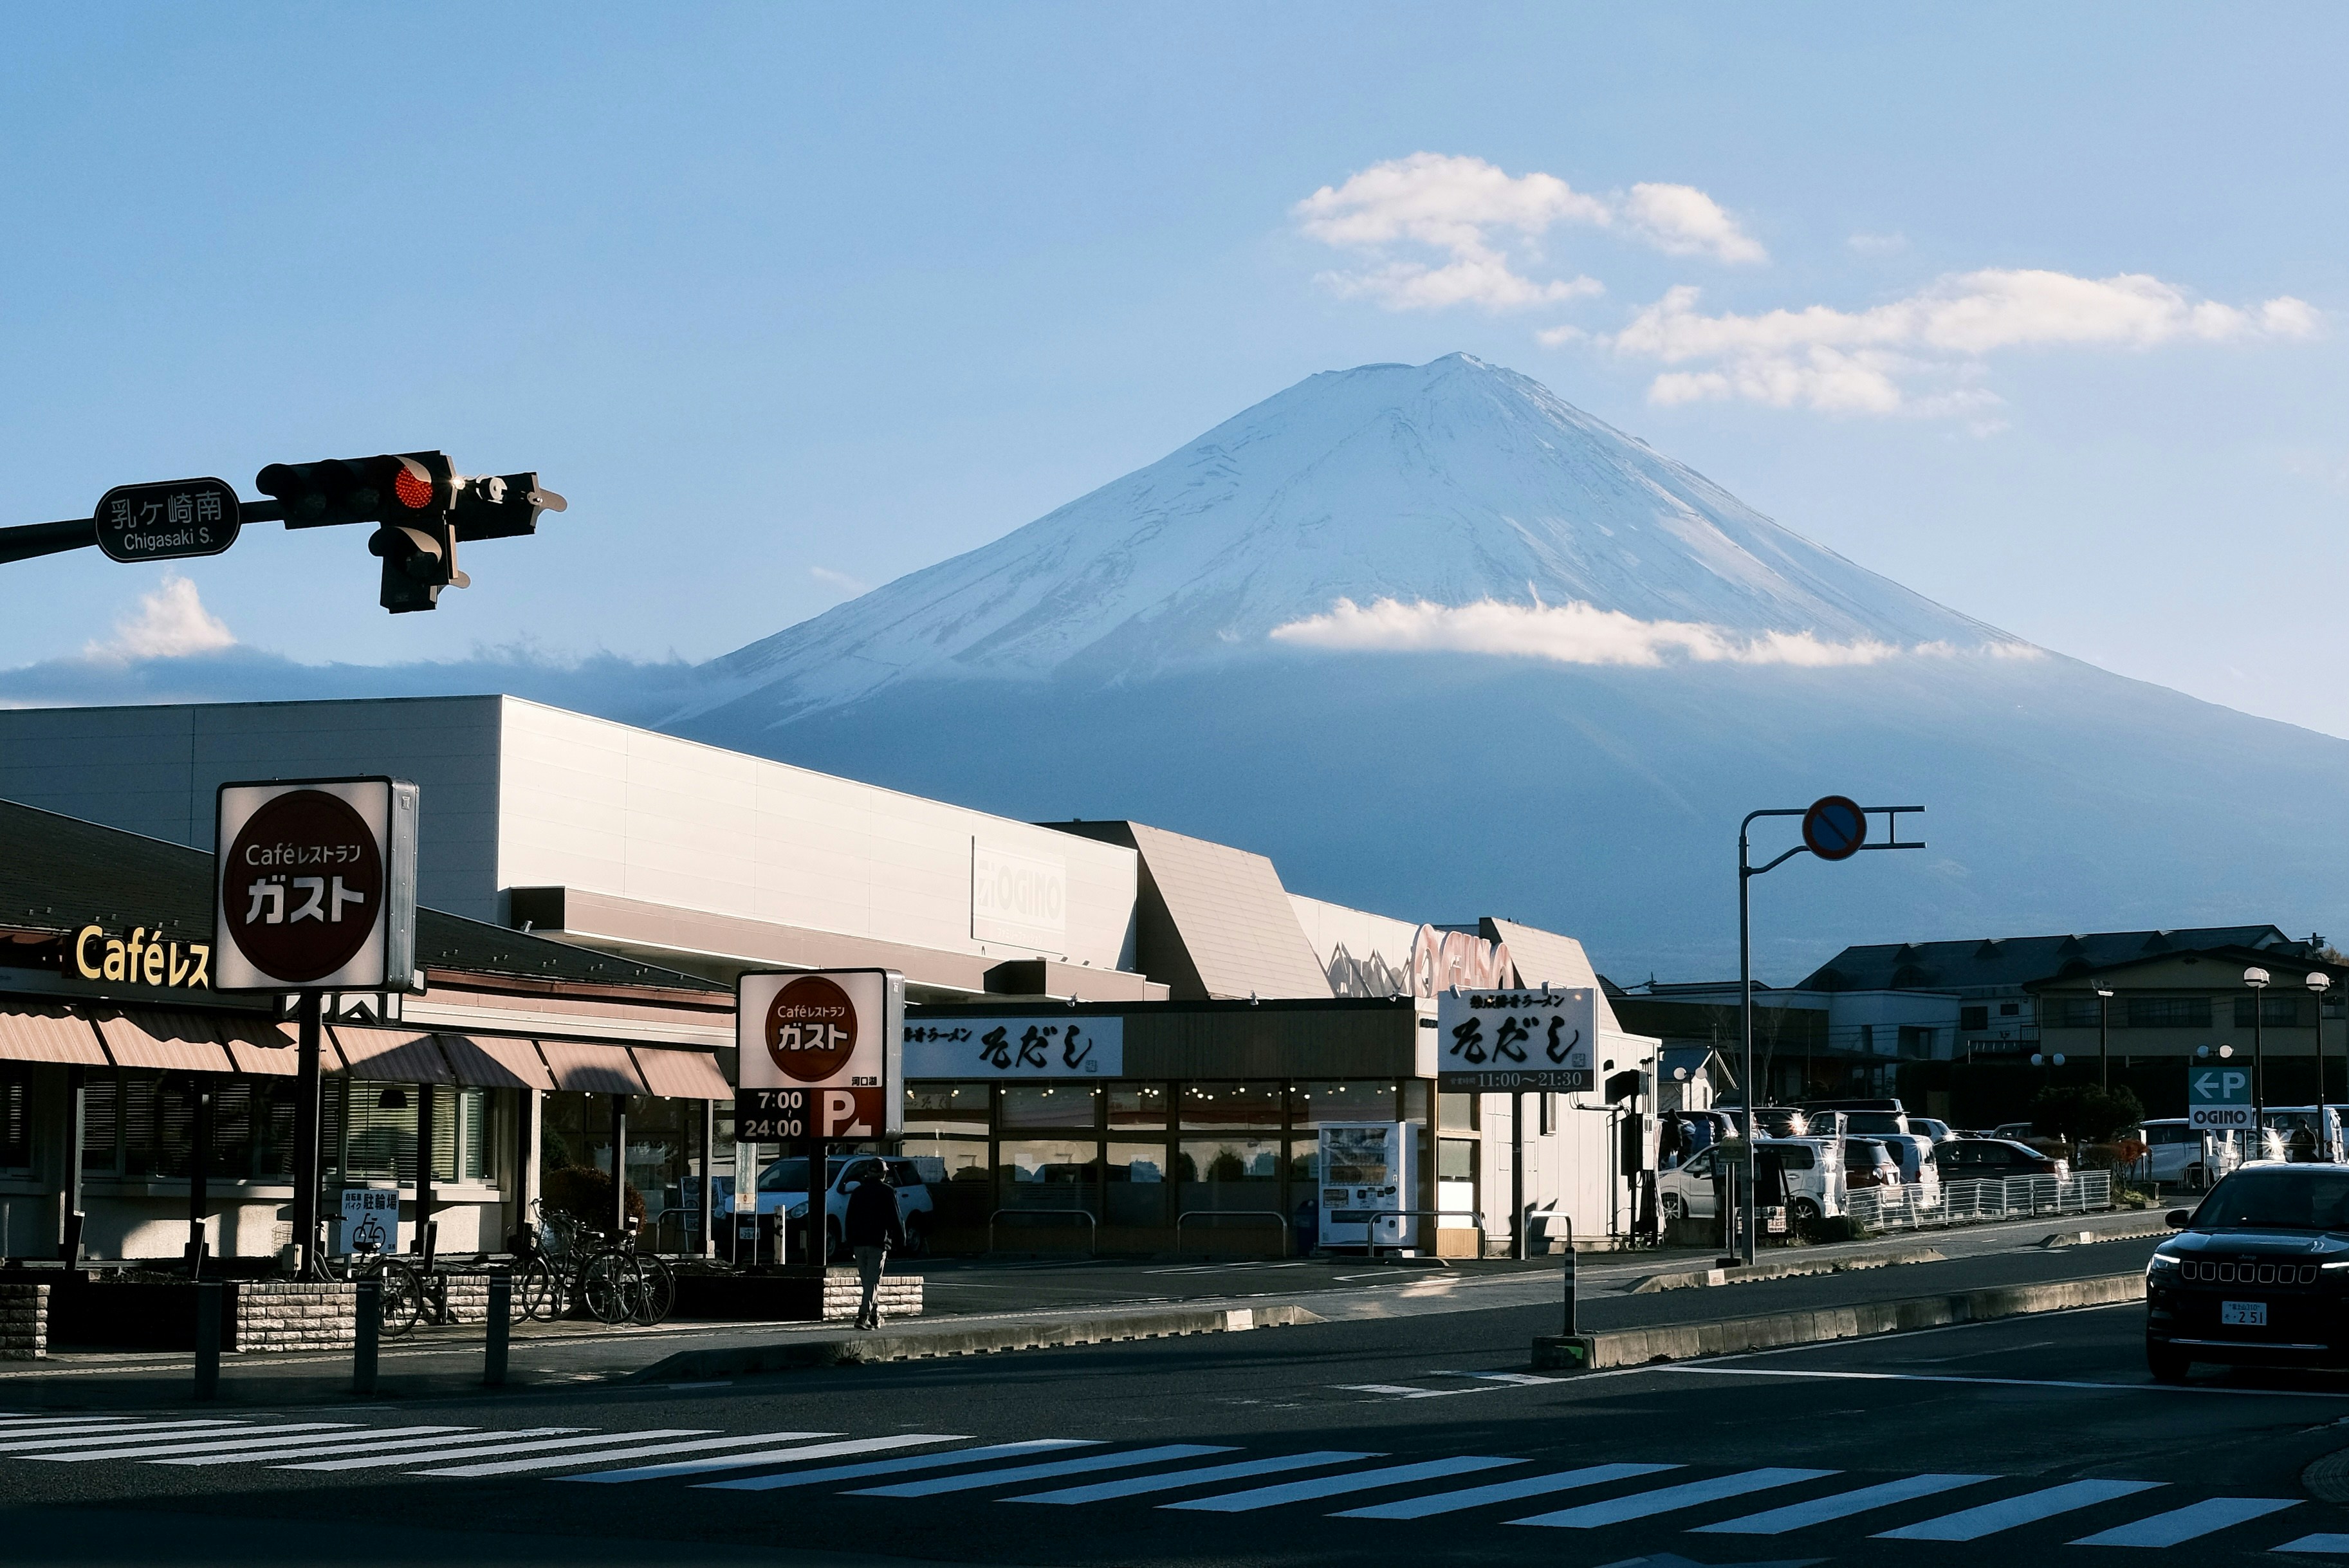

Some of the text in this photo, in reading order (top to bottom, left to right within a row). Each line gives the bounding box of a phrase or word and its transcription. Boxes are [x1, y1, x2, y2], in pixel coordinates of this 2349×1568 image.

[124, 527, 214, 551] Chigasaki S.
[245, 843, 362, 866] Caféレストラン
[246, 874, 365, 925] ガスト
[997, 865, 1062, 920] OGINO
[777, 1004, 845, 1018] Caféレストラン
[778, 1022, 848, 1051] ガスト
[851, 1076, 877, 1086] 河口湖
[2223, 1072, 2246, 1099] P
[758, 1091, 803, 1109] 7:00
[823, 1090, 856, 1137] P
[2193, 1110, 2247, 1125] OGINO
[744, 1120, 802, 1137] 24:00
[345, 1202, 362, 1210] バイク
[363, 1194, 397, 1210] 駐輪場
